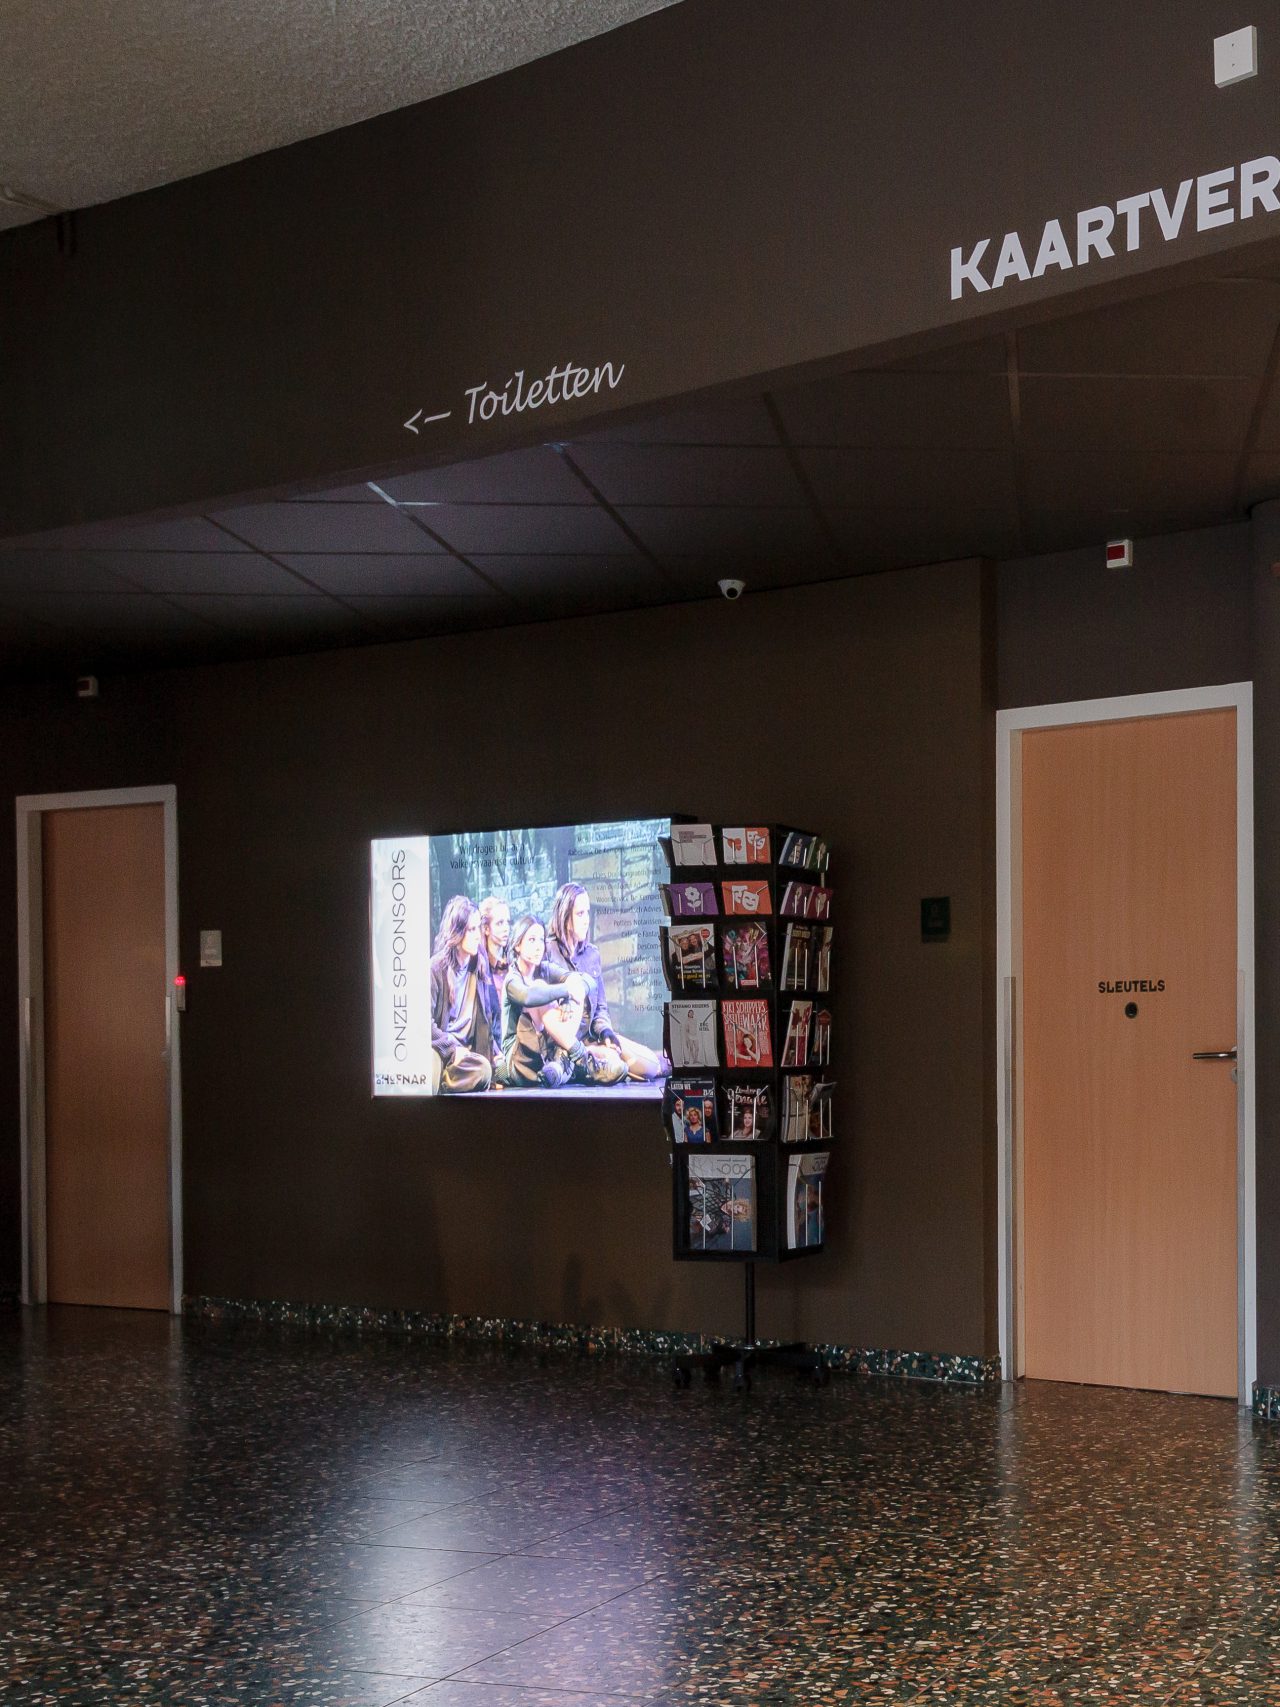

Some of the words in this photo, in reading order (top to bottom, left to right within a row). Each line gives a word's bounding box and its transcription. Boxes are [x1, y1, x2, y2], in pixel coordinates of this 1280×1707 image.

[464, 361, 625, 425] Toiletten
[392, 848, 408, 988] SPONSORS
[1098, 979, 1166, 994] SLEUTELS
[393, 993, 408, 1063] ONZE
